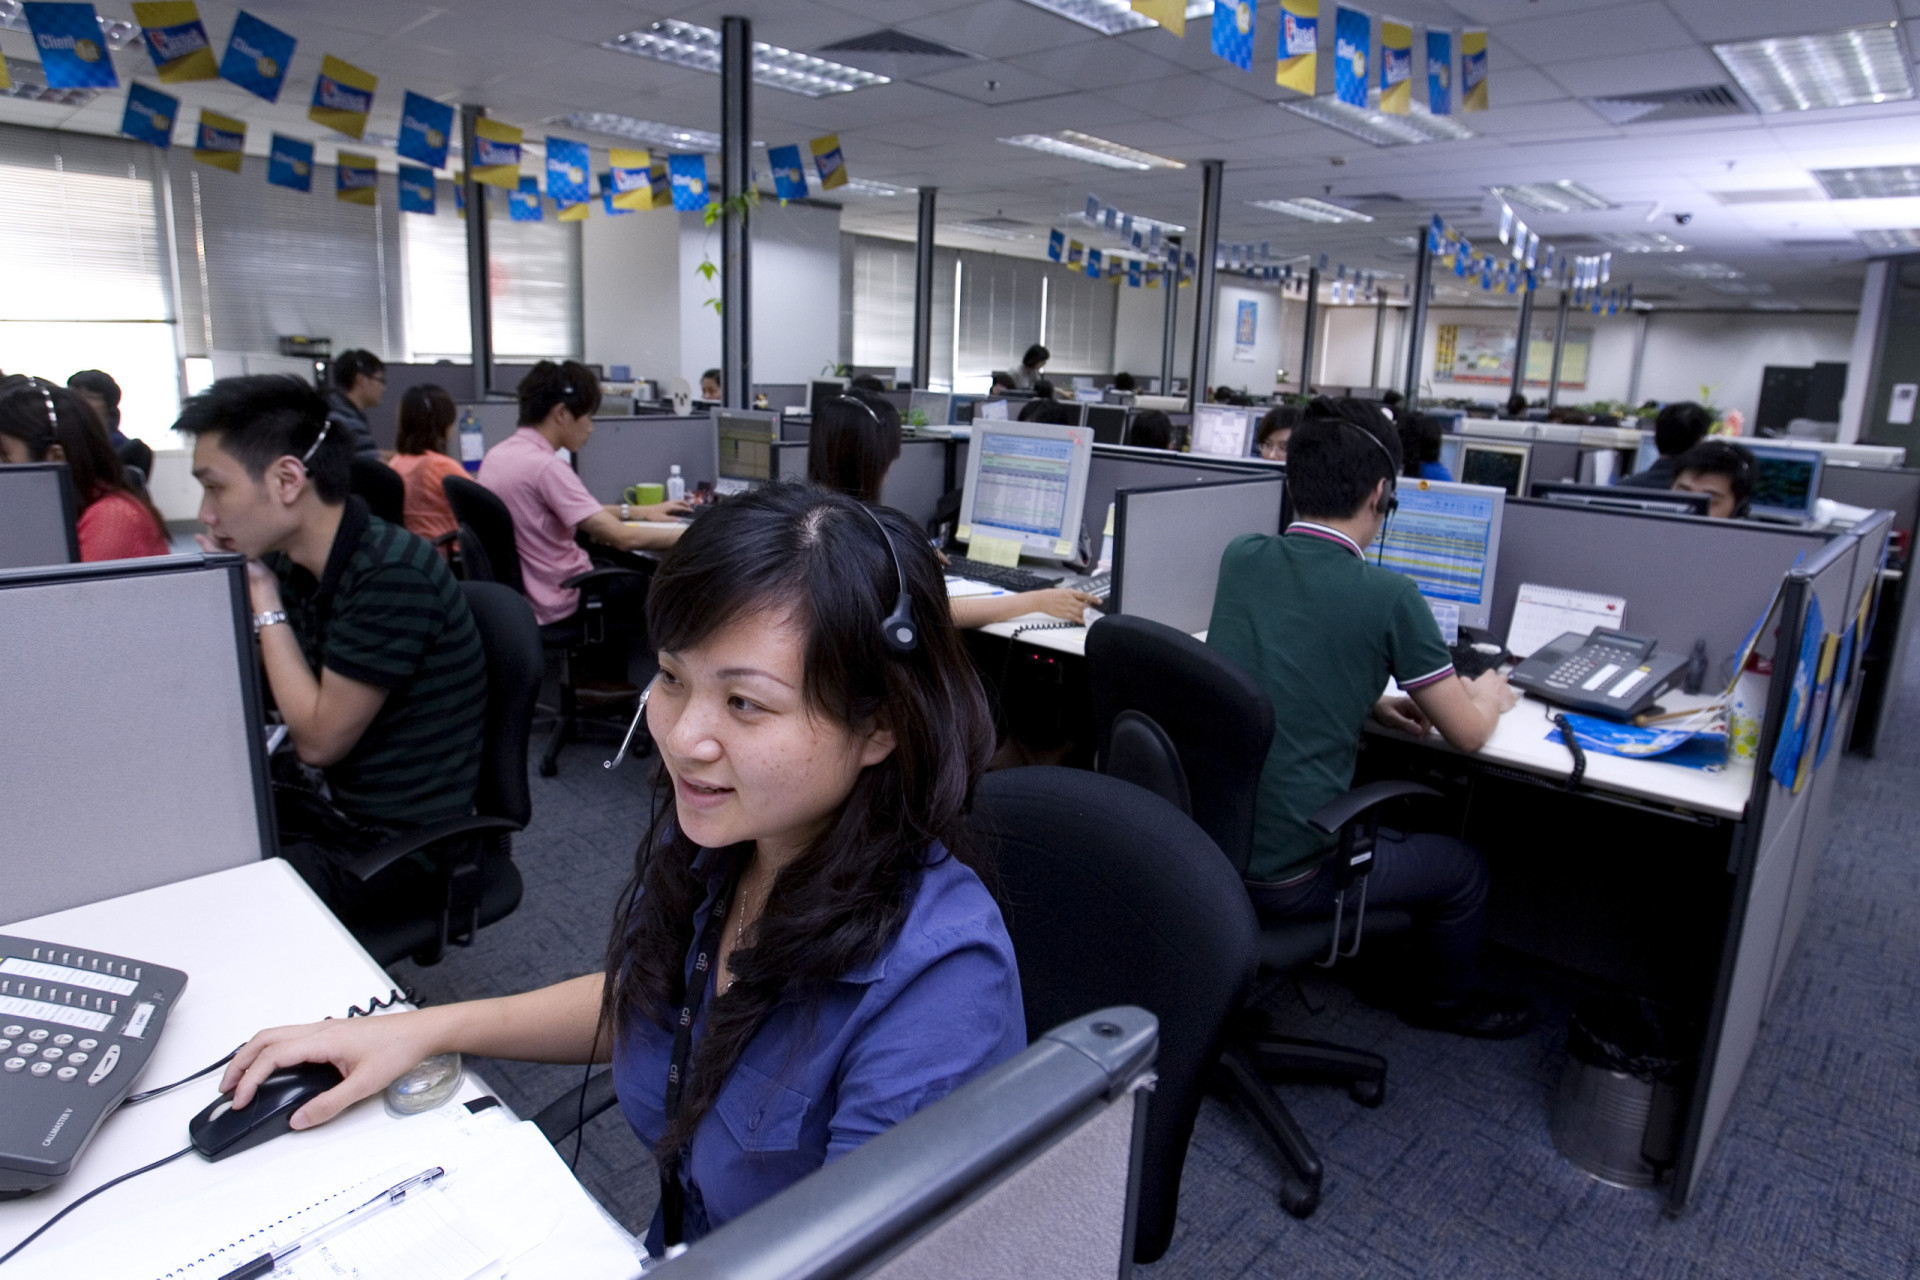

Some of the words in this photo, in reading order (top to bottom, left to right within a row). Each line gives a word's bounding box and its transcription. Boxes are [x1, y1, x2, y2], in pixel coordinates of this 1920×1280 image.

[38, 33, 75, 50] Client
[231, 35, 264, 60] Client
[695, 952, 707, 971] citi
[680, 1007, 689, 1026] citi
[669, 1064, 678, 1083] citi
[42, 1112, 71, 1147] CALLMASTER
